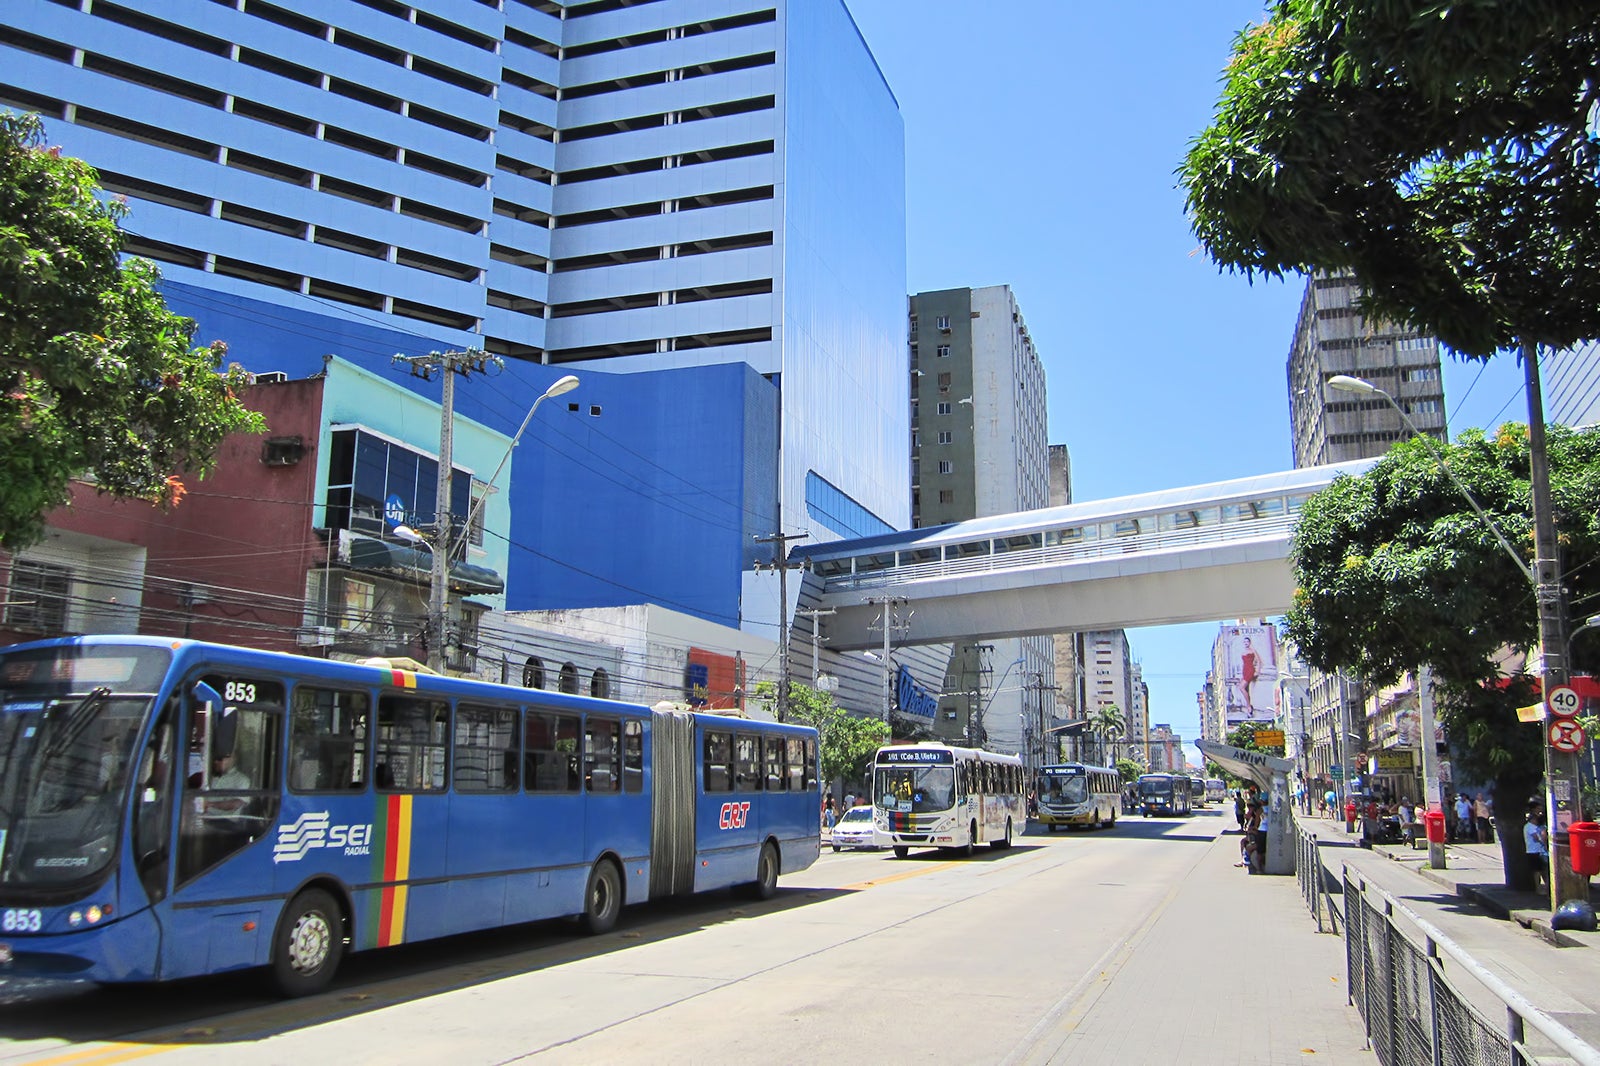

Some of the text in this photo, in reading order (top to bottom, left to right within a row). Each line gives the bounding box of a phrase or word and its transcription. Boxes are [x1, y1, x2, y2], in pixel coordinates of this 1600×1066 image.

[225, 681, 256, 703] 853
[1553, 693, 1576, 706] 40
[719, 801, 750, 830] CRT
[326, 824, 373, 847] SEI
[344, 846, 370, 856] RADIAL
[3, 908, 42, 931] 853
